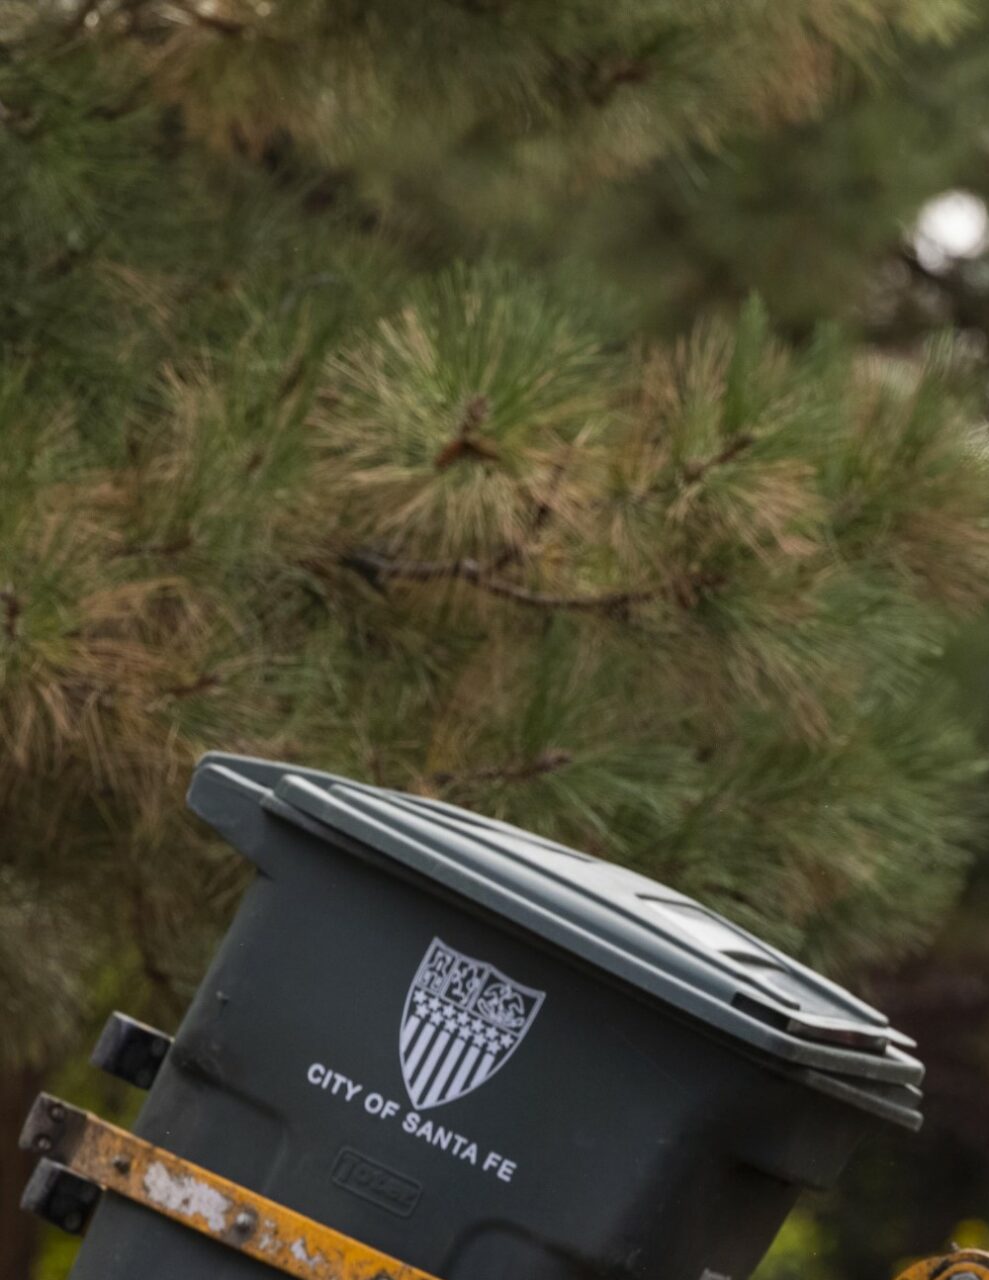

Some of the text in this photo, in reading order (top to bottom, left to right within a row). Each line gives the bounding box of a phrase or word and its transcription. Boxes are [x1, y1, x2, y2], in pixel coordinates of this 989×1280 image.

[307, 1063, 518, 1182] CITY OF SANTA FE
